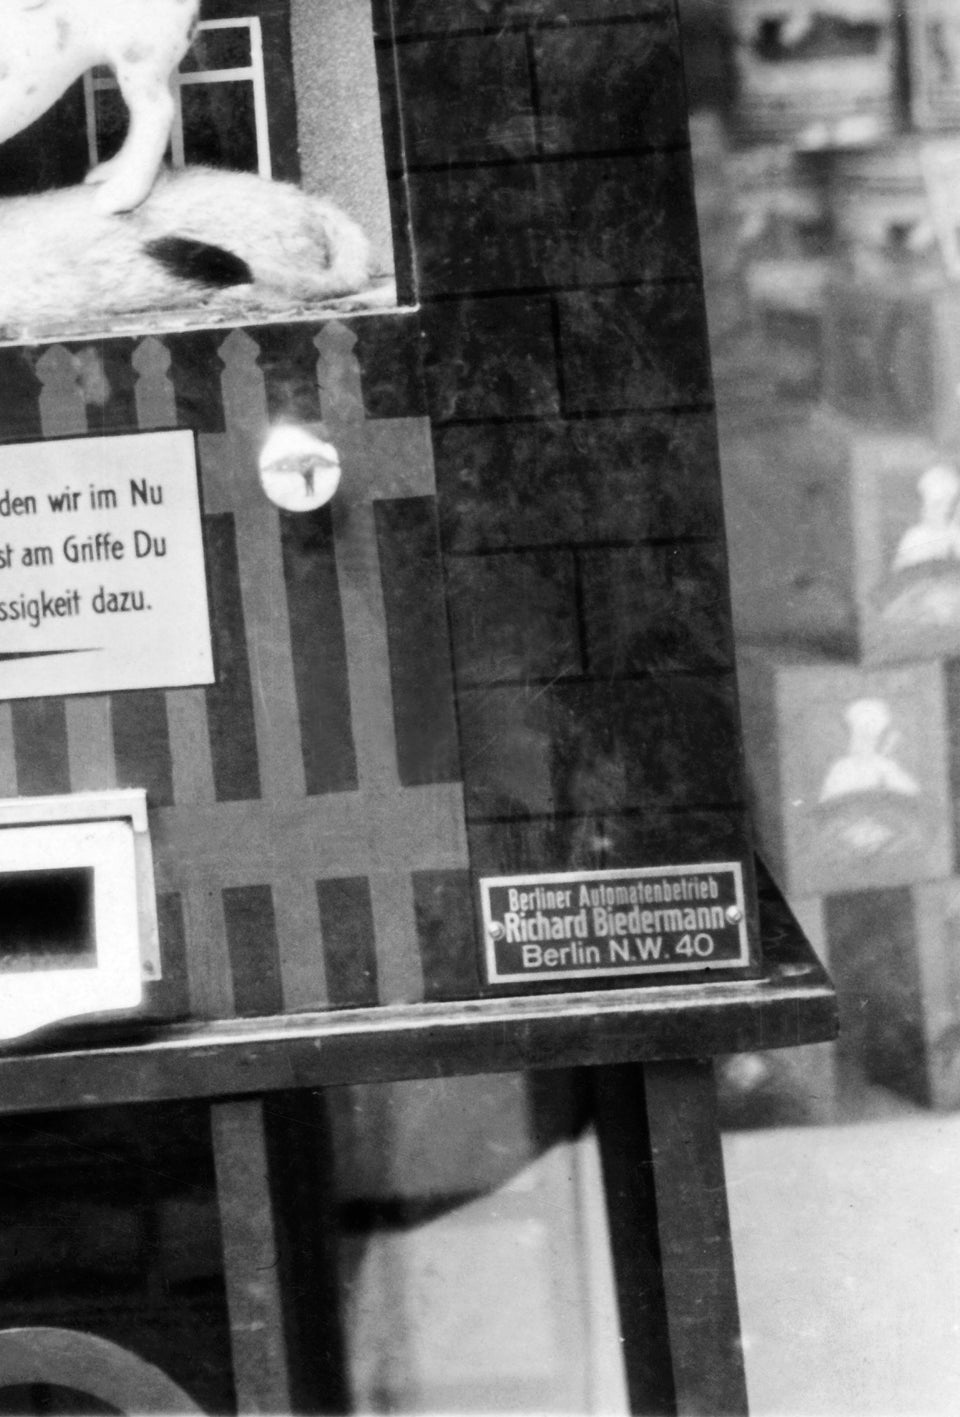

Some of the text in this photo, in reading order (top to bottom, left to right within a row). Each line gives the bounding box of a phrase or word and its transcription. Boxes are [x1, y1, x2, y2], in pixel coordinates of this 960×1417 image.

[48, 486, 82, 513] wir
[90, 484, 118, 510] im
[130, 477, 163, 507] Nu
[21, 546, 54, 567] am
[62, 532, 125, 564] Griffe
[133, 529, 168, 559] Du
[92, 586, 153, 615] dazu.
[508, 876, 719, 912] Berliner Automatenbetrieb
[504, 905, 726, 943] Richard Biedermann
[522, 941, 601, 968] Berlin
[675, 933, 715, 957] 40
